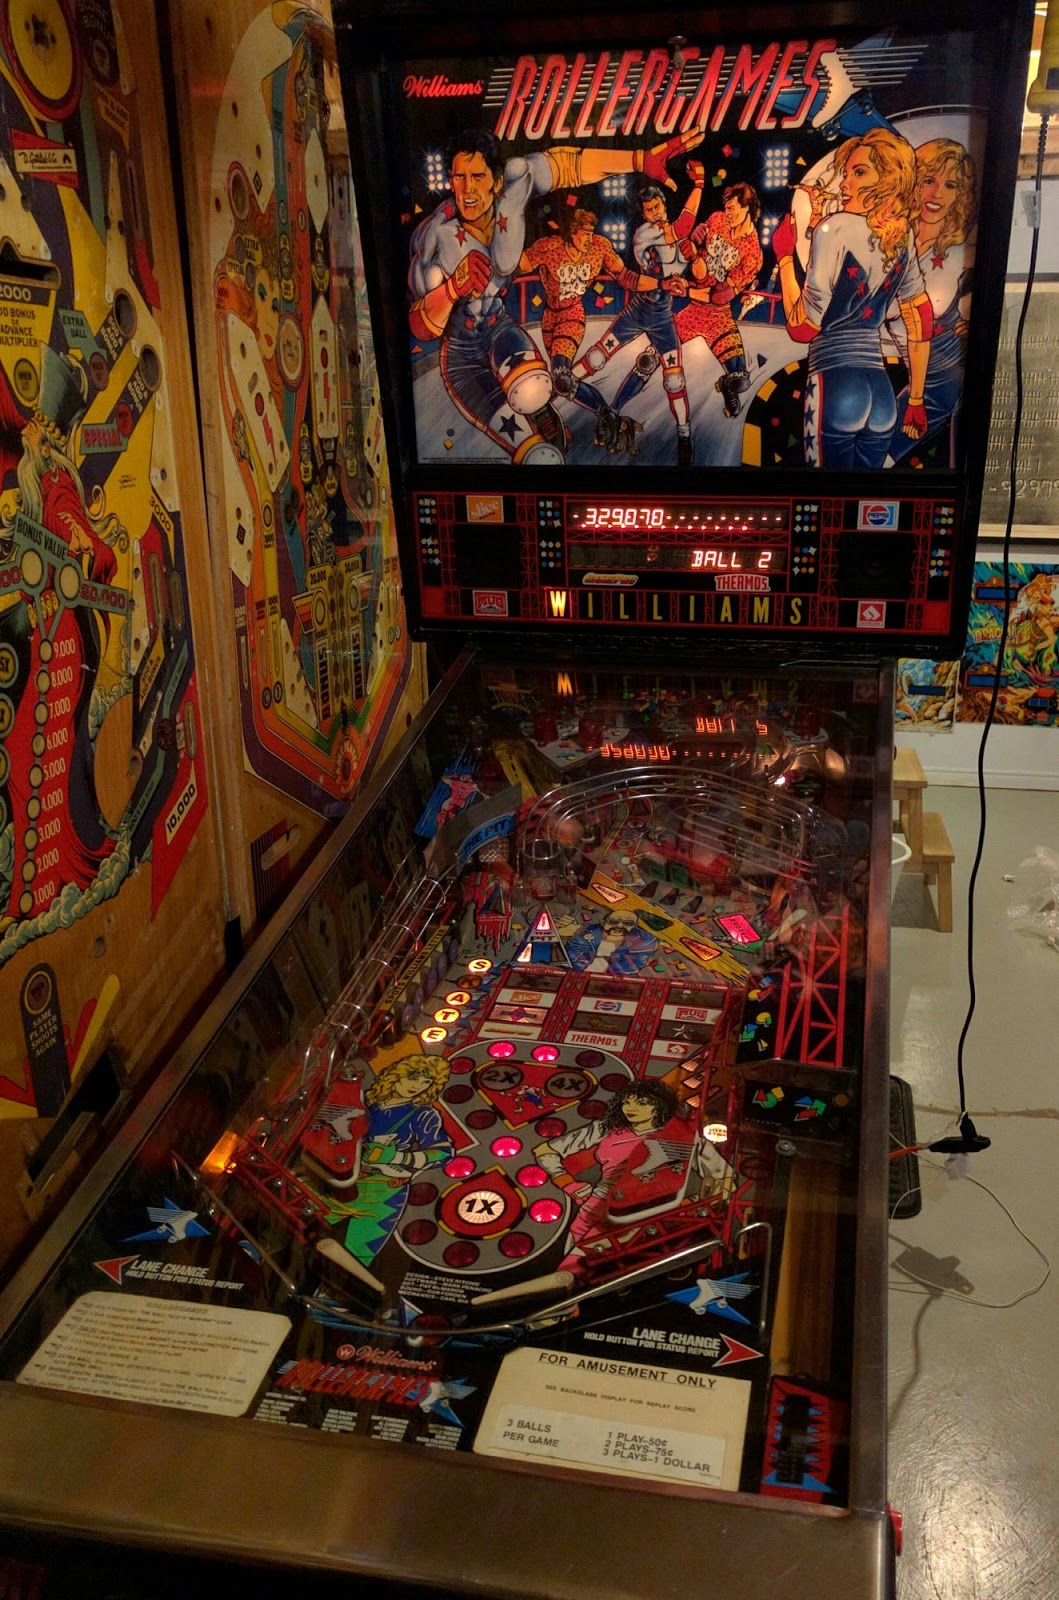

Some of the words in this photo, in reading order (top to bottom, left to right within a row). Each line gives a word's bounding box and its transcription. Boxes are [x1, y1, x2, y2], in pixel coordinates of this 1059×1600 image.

[403, 75, 483, 98] Williams
[495, 38, 836, 141] ROLLERGAMES
[11, 307, 36, 320] BONUS
[62, 315, 85, 327] EXTRA
[0, 324, 33, 336] ADVANCE
[70, 328, 88, 339] BALL
[101, 327, 117, 361] BONUS
[127, 381, 143, 414] BONUS
[83, 427, 122, 448] SPECIAL
[471, 499, 499, 518] slice
[586, 508, 664, 526] 329070
[16, 518, 43, 547] BONUS
[43, 534, 67, 562] VALUE
[691, 550, 742, 568] BALL
[758, 551, 772, 569] 2
[80, 583, 126, 609] 20,000
[974, 622, 1016, 643] DRAGN
[53, 638, 76, 659] 9,000
[50, 665, 73, 688] 8,000
[48, 696, 71, 719] 7,000
[46, 727, 68, 751] 6,000
[43, 757, 66, 781] 5,000
[41, 788, 64, 812] 4,000
[167, 783, 196, 833] 10,000
[38, 817, 61, 843] 3,000
[485, 818, 508, 837] PIT
[36, 848, 59, 874] 2,000
[33, 880, 55, 906] 1,000
[29, 1014, 58, 1041] PLAYER
[33, 1008, 52, 1028] SAME
[31, 1024, 58, 1050] SHOOTS
[35, 1037, 57, 1057] AGAIN
[485, 1070, 518, 1085] 2X
[551, 1077, 584, 1092] 4X
[465, 1197, 499, 1215] 1X
[130, 1260, 163, 1273] LANE
[162, 1263, 210, 1278] CHANGE
[583, 1331, 605, 1342] HOLD
[606, 1335, 638, 1347] BUTTON
[639, 1339, 656, 1349] FOR
[656, 1342, 687, 1354] STATUS
[687, 1346, 720, 1358] REPORT
[632, 1327, 666, 1342] LANE
[668, 1332, 721, 1350] CHANGE
[356, 1345, 434, 1372] Williams
[538, 1352, 568, 1366] FOR
[576, 1359, 668, 1382] AMUSEMENT
[677, 1374, 717, 1389] ONLY
[600, 1394, 626, 1403] DISPLAY
[646, 1401, 671, 1410] REPLAY
[674, 1404, 696, 1413] SCORE
[506, 1419, 514, 1427] 3
[517, 1420, 551, 1433] BALLS
[607, 1431, 613, 1439] 1
[503, 1431, 524, 1442] PER
[528, 1435, 560, 1448] GAME
[604, 1440, 611, 1448] 2
[602, 1448, 609, 1456] 3
[663, 1457, 711, 1473] DOLLAR
